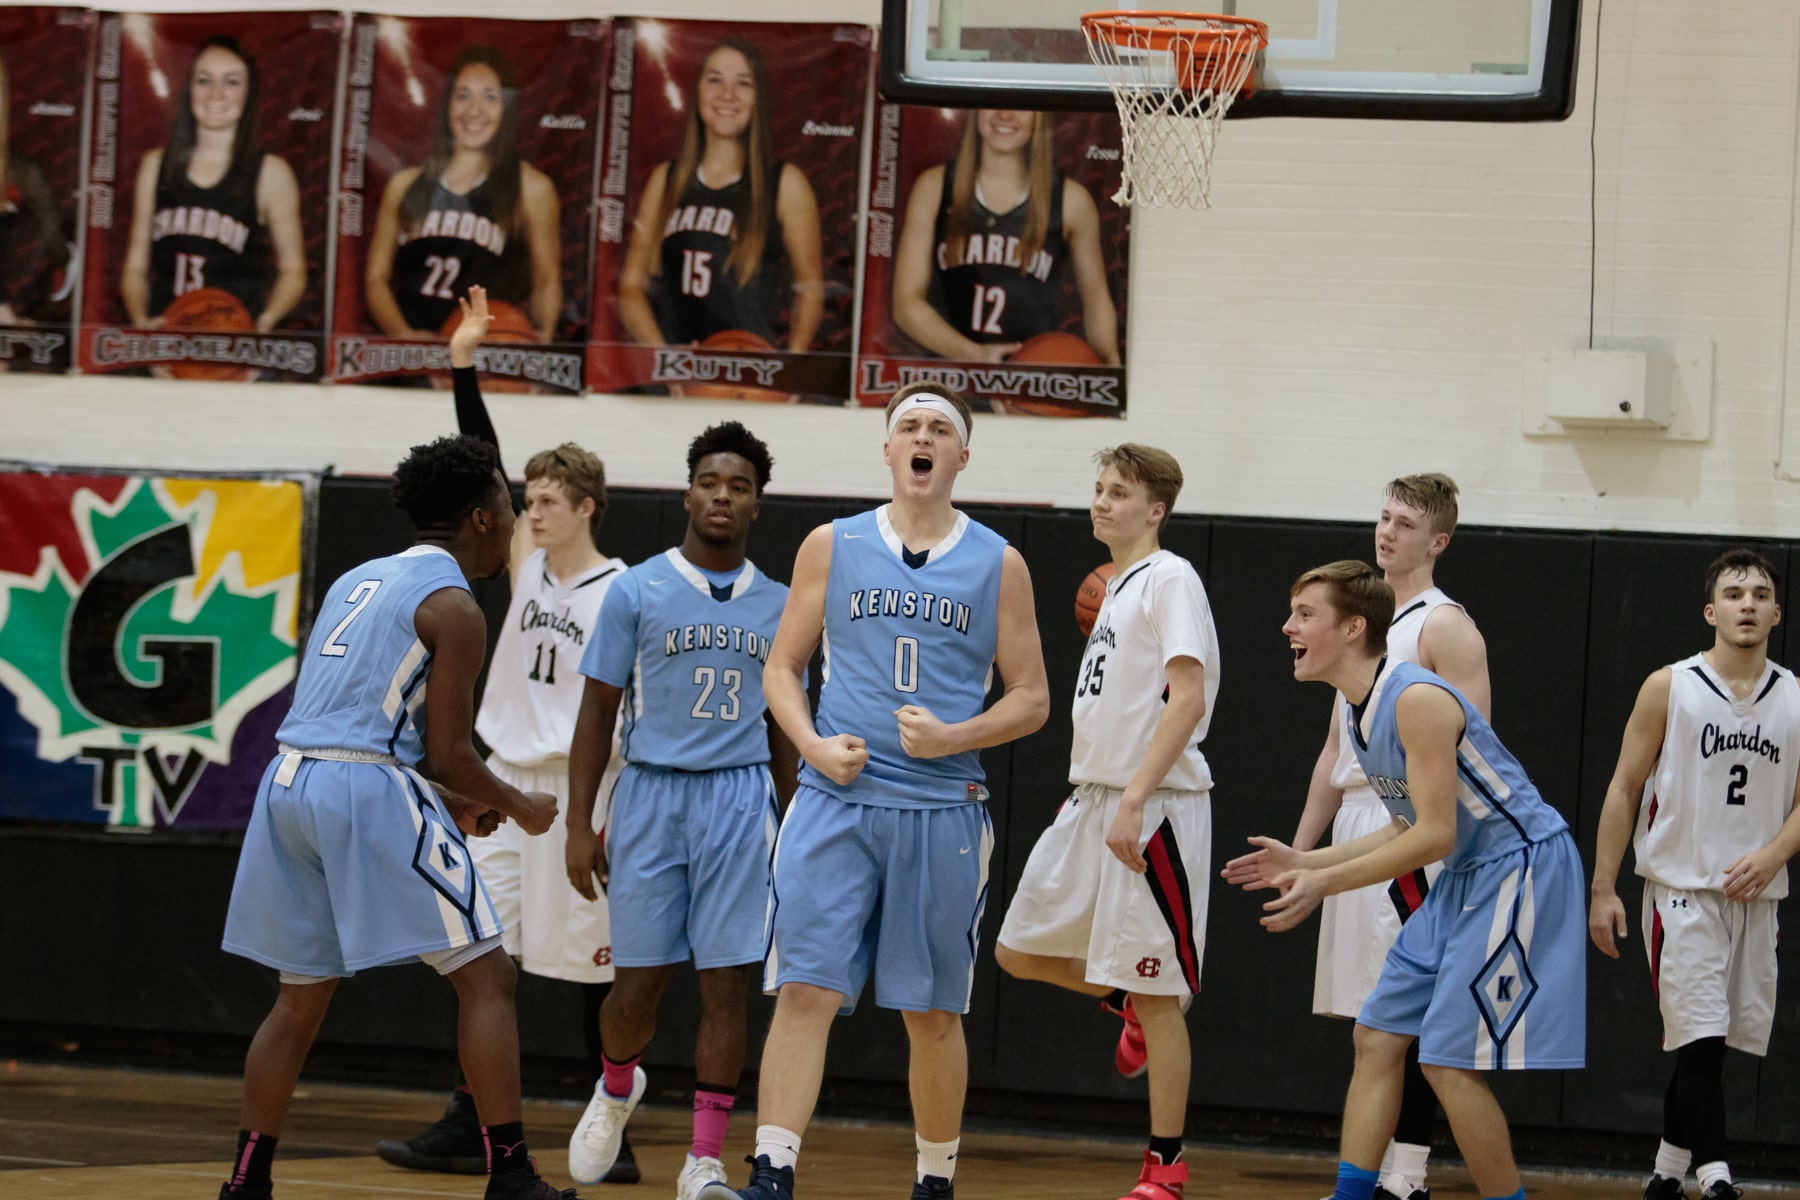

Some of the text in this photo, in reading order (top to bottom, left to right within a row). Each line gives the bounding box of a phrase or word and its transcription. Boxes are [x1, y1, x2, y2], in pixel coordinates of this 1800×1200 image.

[599, 197, 625, 244] 2017
[869, 210, 894, 258] 2017
[420, 255, 461, 299] 22
[681, 249, 713, 298] 15
[971, 283, 1006, 335] 12
[92, 328, 317, 374] CREMEANS
[335, 338, 583, 391] KOBUSEWSKI
[653, 348, 784, 386] KUTY
[319, 578, 383, 658] 2
[520, 599, 585, 646] Chardon
[849, 588, 971, 635] KENSTON
[528, 640, 558, 686] 11
[1077, 653, 1107, 699] 35
[690, 666, 743, 722] 23
[1700, 722, 1781, 765] Chardon
[1726, 764, 1749, 807] 2
[437, 841, 463, 872] K
[1496, 974, 1517, 1003] K
